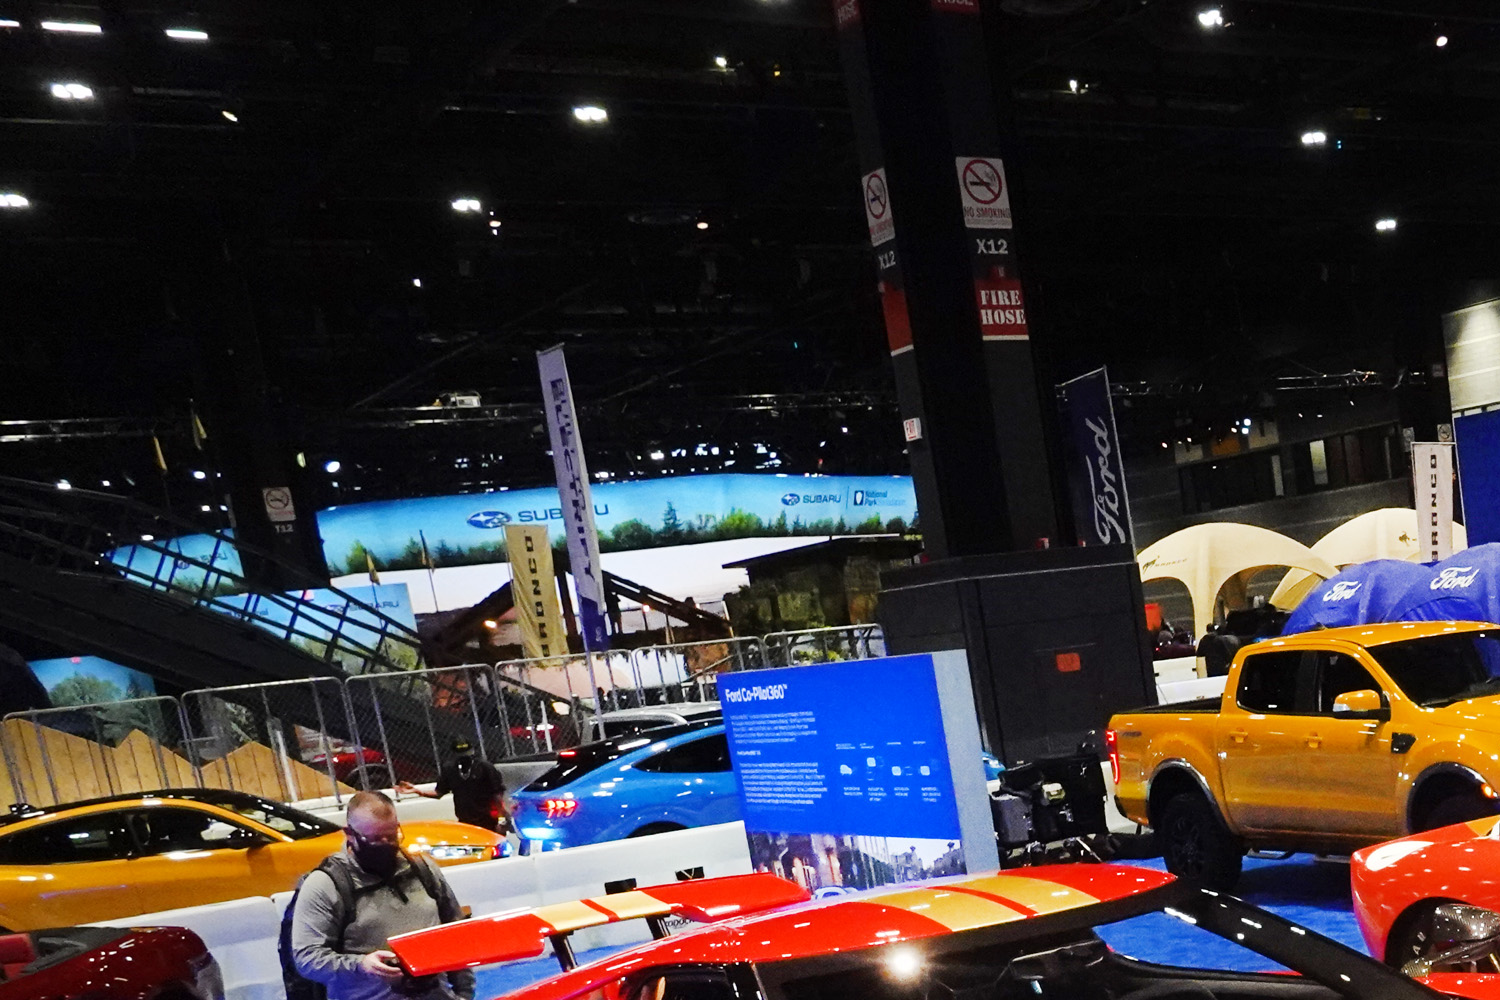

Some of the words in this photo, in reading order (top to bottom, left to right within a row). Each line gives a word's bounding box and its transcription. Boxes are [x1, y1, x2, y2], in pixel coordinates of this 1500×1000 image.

[976, 238, 1009, 254] X12
[878, 250, 896, 270] X12
[980, 289, 1021, 305] FIRE
[980, 309, 1026, 325] HOSE
[1084, 415, 1126, 545] Ford
[802, 494, 842, 504] SUBARU
[1430, 454, 1439, 562] BRONCO
[517, 503, 610, 522] SUBU
[275, 524, 295, 533] T12
[1430, 566, 1480, 590] Ford
[524, 535, 550, 658] BRONCO
[1322, 580, 1362, 602] Ford
[725, 687, 743, 702] Ford
